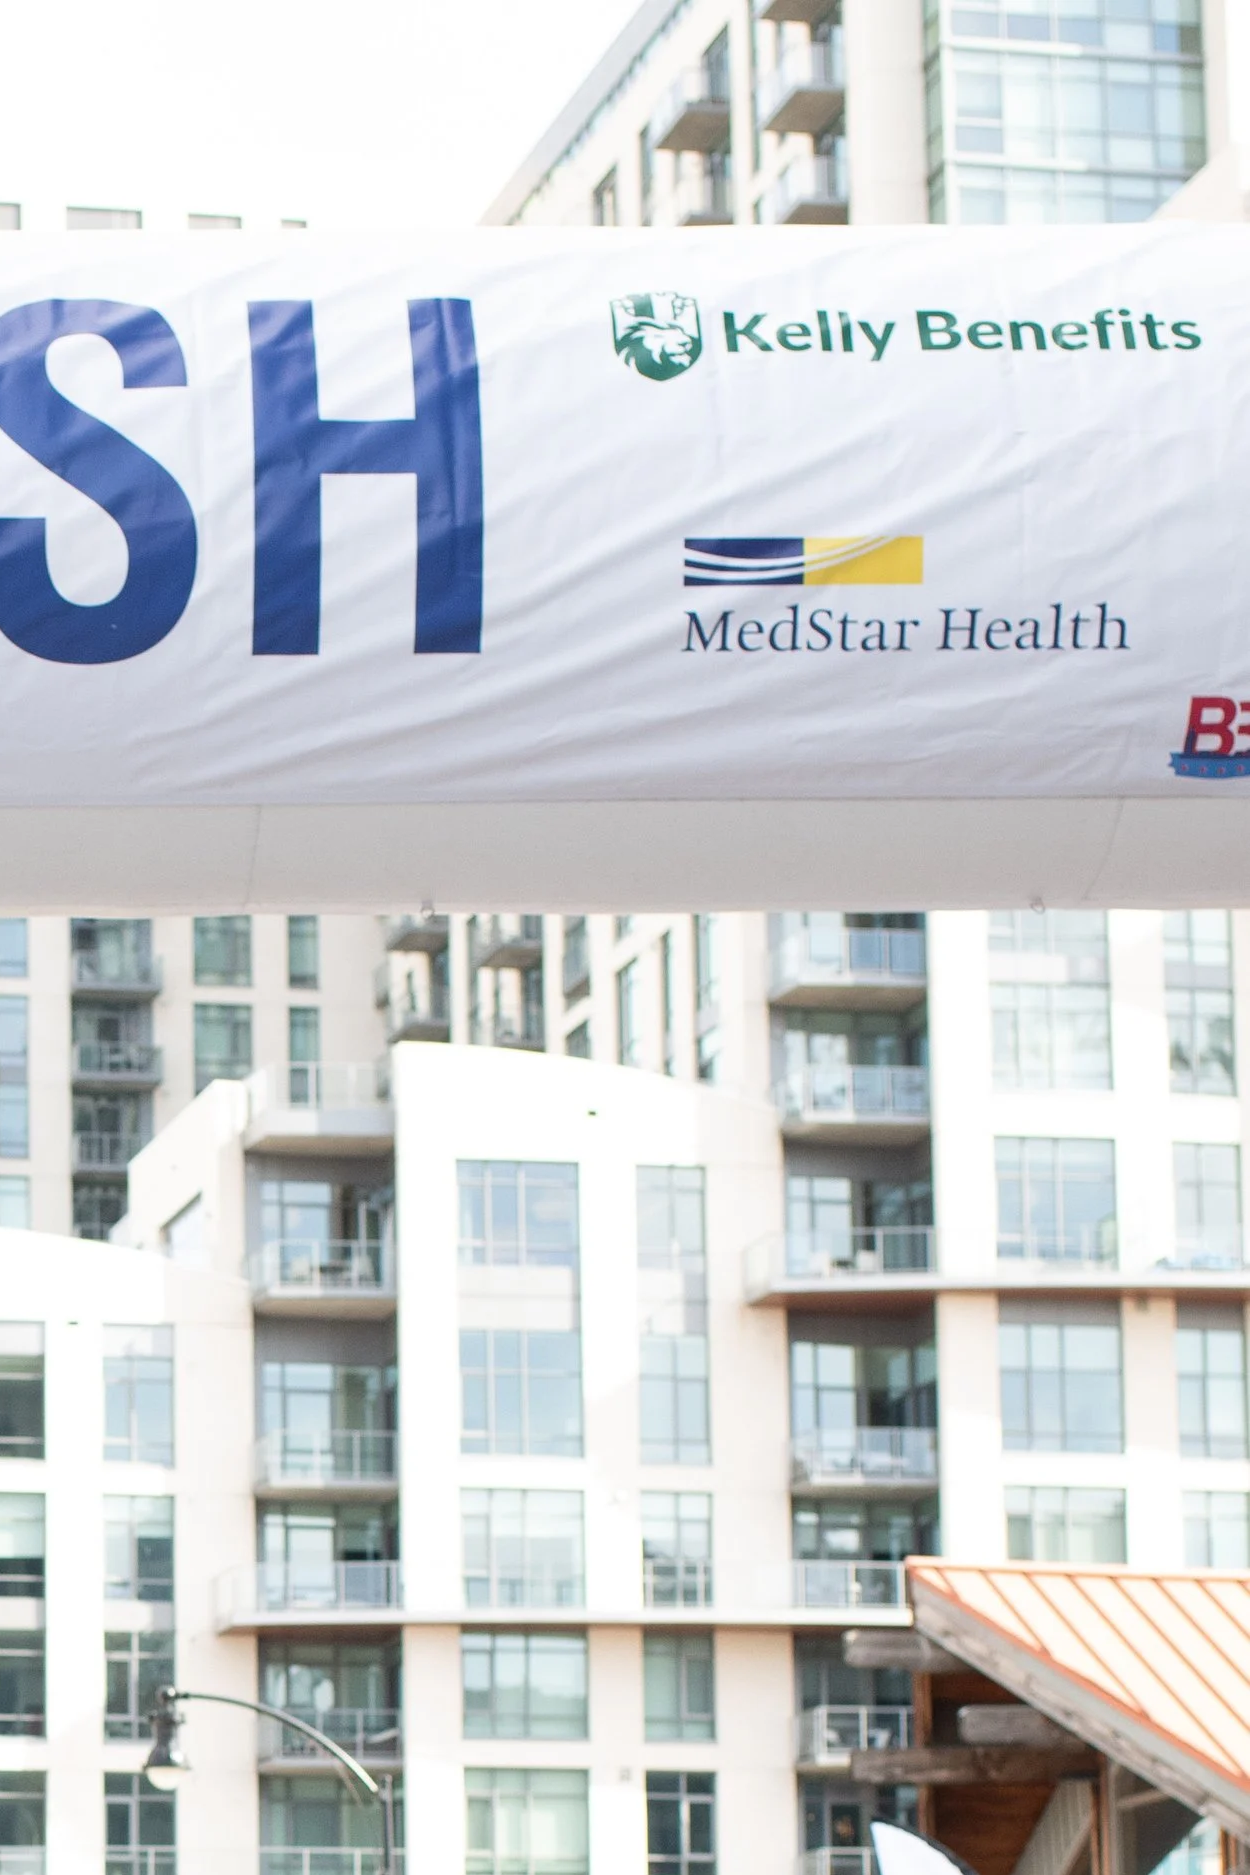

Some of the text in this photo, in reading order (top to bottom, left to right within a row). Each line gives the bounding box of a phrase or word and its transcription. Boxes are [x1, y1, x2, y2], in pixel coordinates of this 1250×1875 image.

[722, 308, 1203, 361] Kelly Benefits
[681, 602, 1131, 653] MedStar Health
